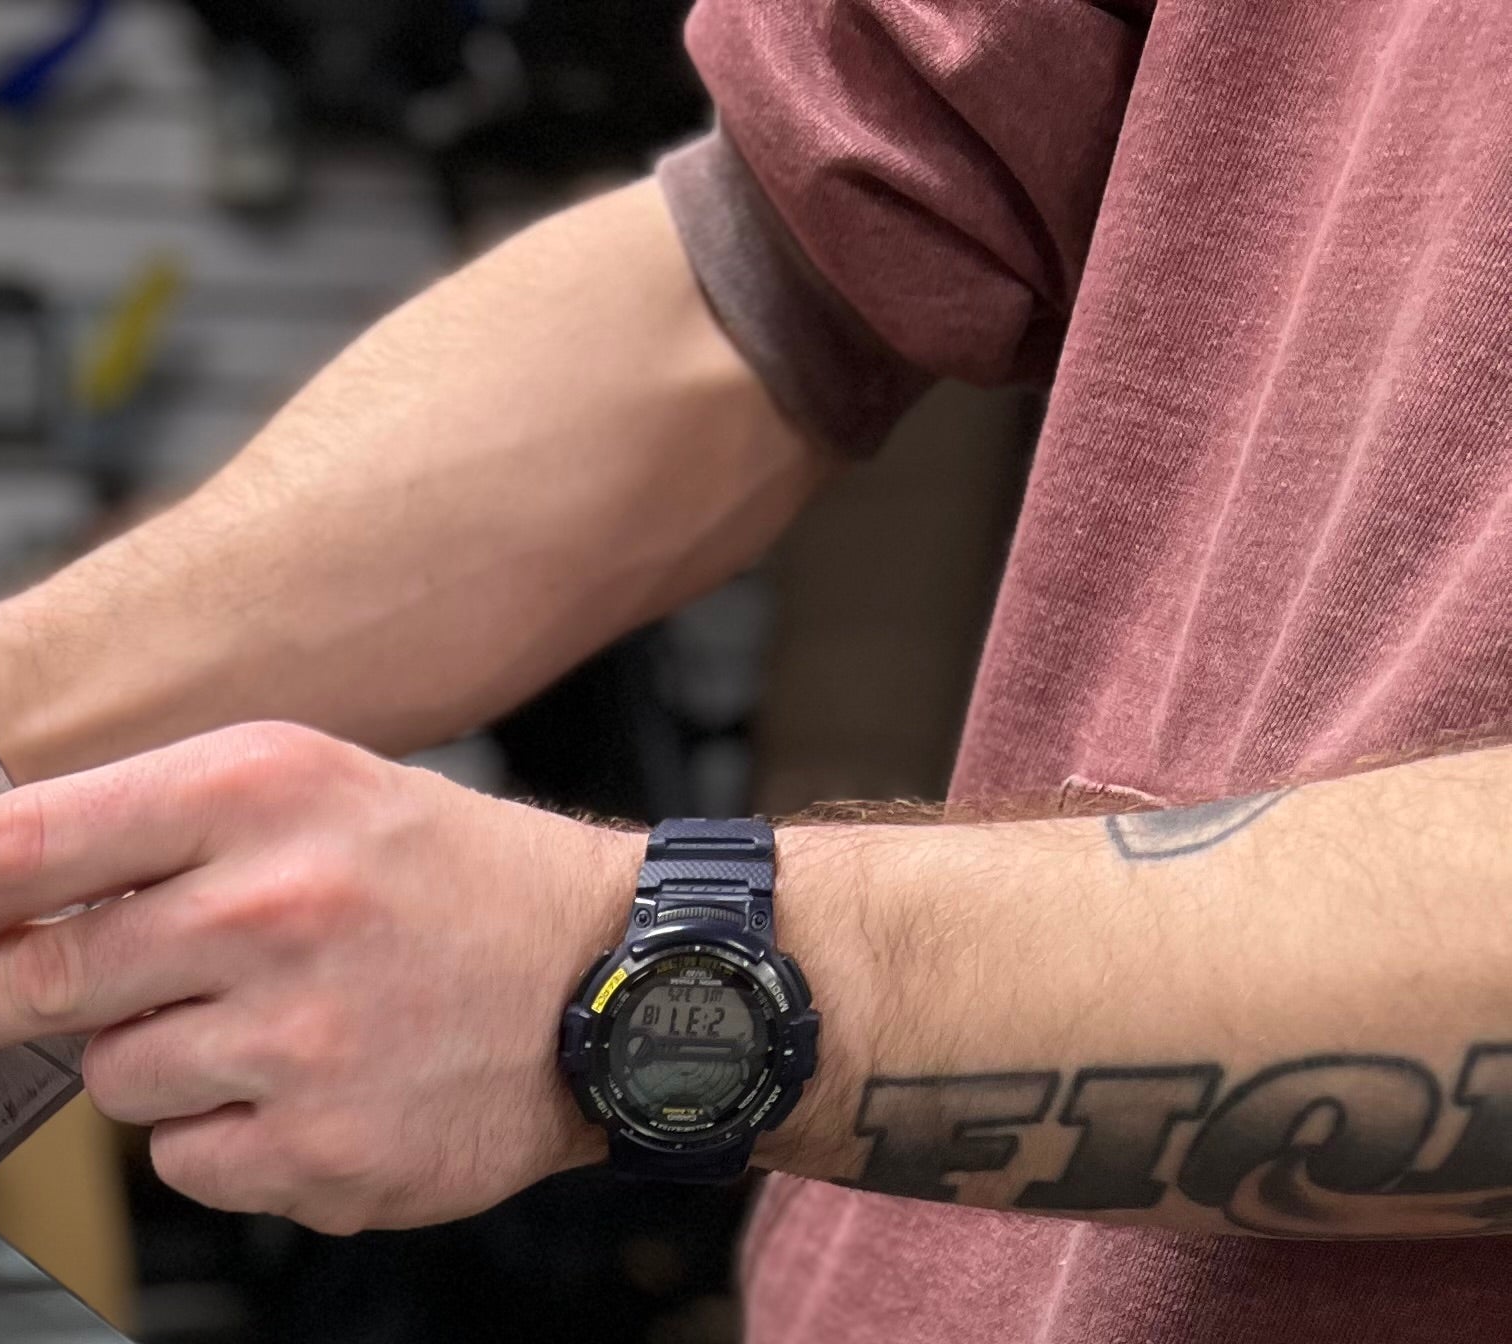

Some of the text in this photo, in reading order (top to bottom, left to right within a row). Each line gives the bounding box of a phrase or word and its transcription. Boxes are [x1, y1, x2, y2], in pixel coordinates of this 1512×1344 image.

[766, 980, 790, 1013] MODE
[669, 1007, 726, 1039] 2:37
[589, 1086, 614, 1119] LIGHT
[749, 1084, 782, 1128] ADJUST
